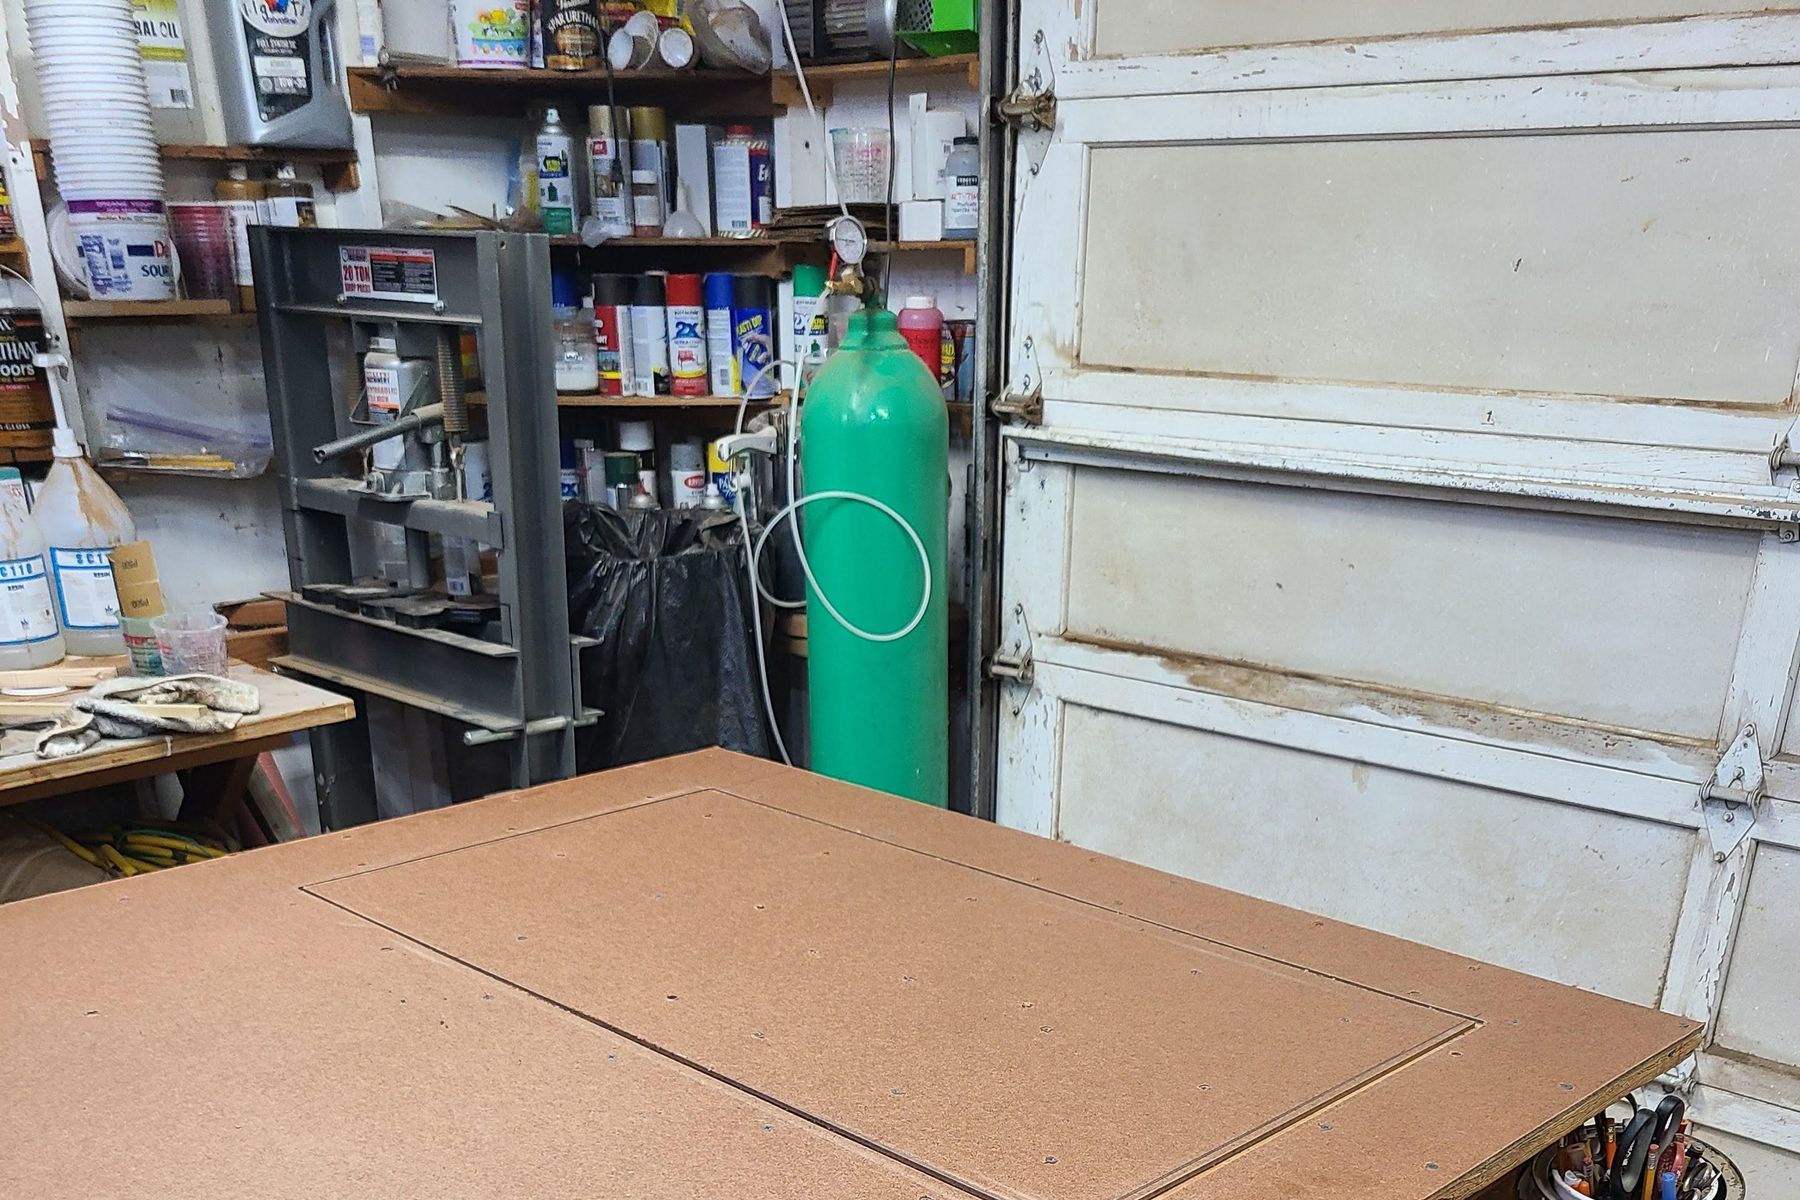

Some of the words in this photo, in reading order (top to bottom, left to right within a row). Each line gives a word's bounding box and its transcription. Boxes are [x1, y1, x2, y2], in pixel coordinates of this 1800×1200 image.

[159, 21, 179, 39] OIL
[343, 265, 354, 281] 20
[355, 266, 370, 282] TON
[675, 321, 700, 338] 2X
